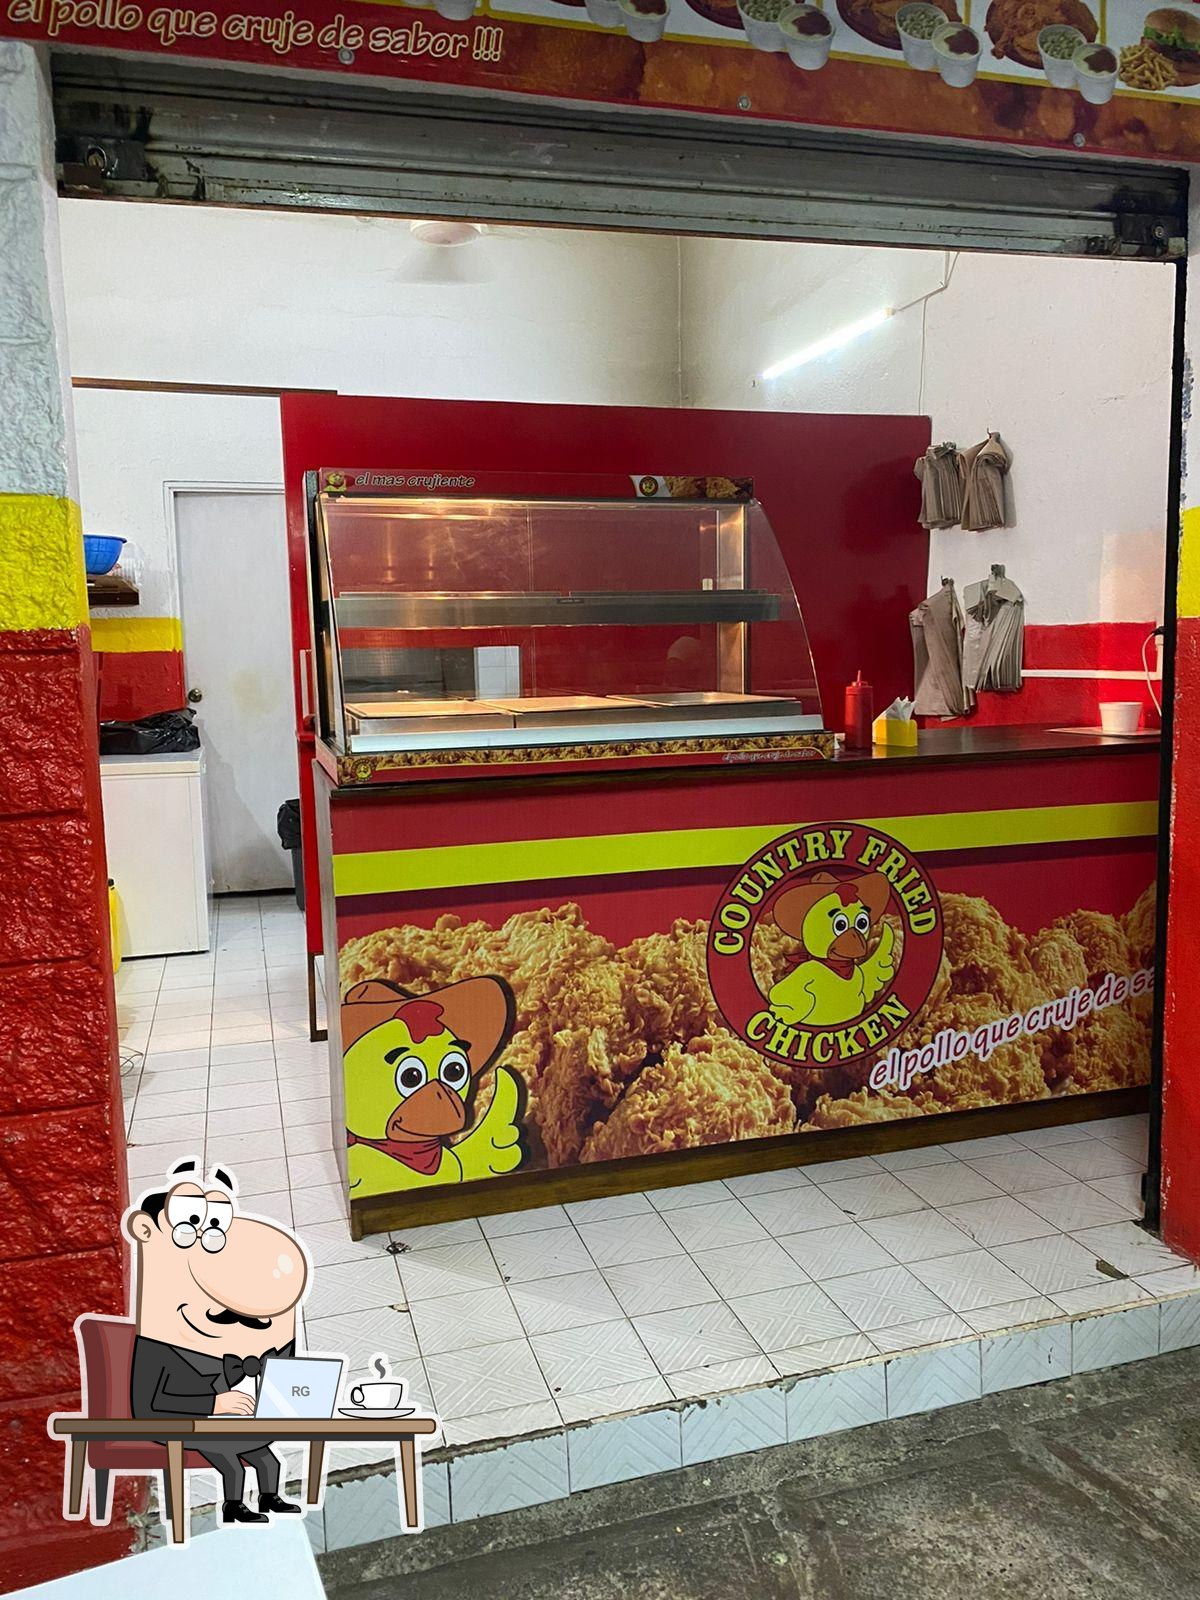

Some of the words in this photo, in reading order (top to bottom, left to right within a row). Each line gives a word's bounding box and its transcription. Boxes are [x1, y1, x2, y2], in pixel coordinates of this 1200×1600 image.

[7, 0, 43, 22] el
[47, 0, 142, 36] pollo
[148, 8, 217, 45] que
[222, 11, 314, 54] cruje
[317, 14, 364, 49] de
[369, 21, 468, 58] sabor
[472, 26, 503, 61] !!!
[355, 472, 370, 486] el
[372, 475, 404, 486] mas
[407, 474, 475, 490] crujiente
[713, 829, 852, 955] COUNTRY
[858, 836, 937, 935] FRIED
[746, 994, 911, 1063] CHICKEN
[870, 1049, 898, 1088] el
[901, 1029, 970, 1090] pollo
[971, 1014, 1022, 1061] que
[1024, 988, 1093, 1030] cruje
[1095, 973, 1128, 1010] de
